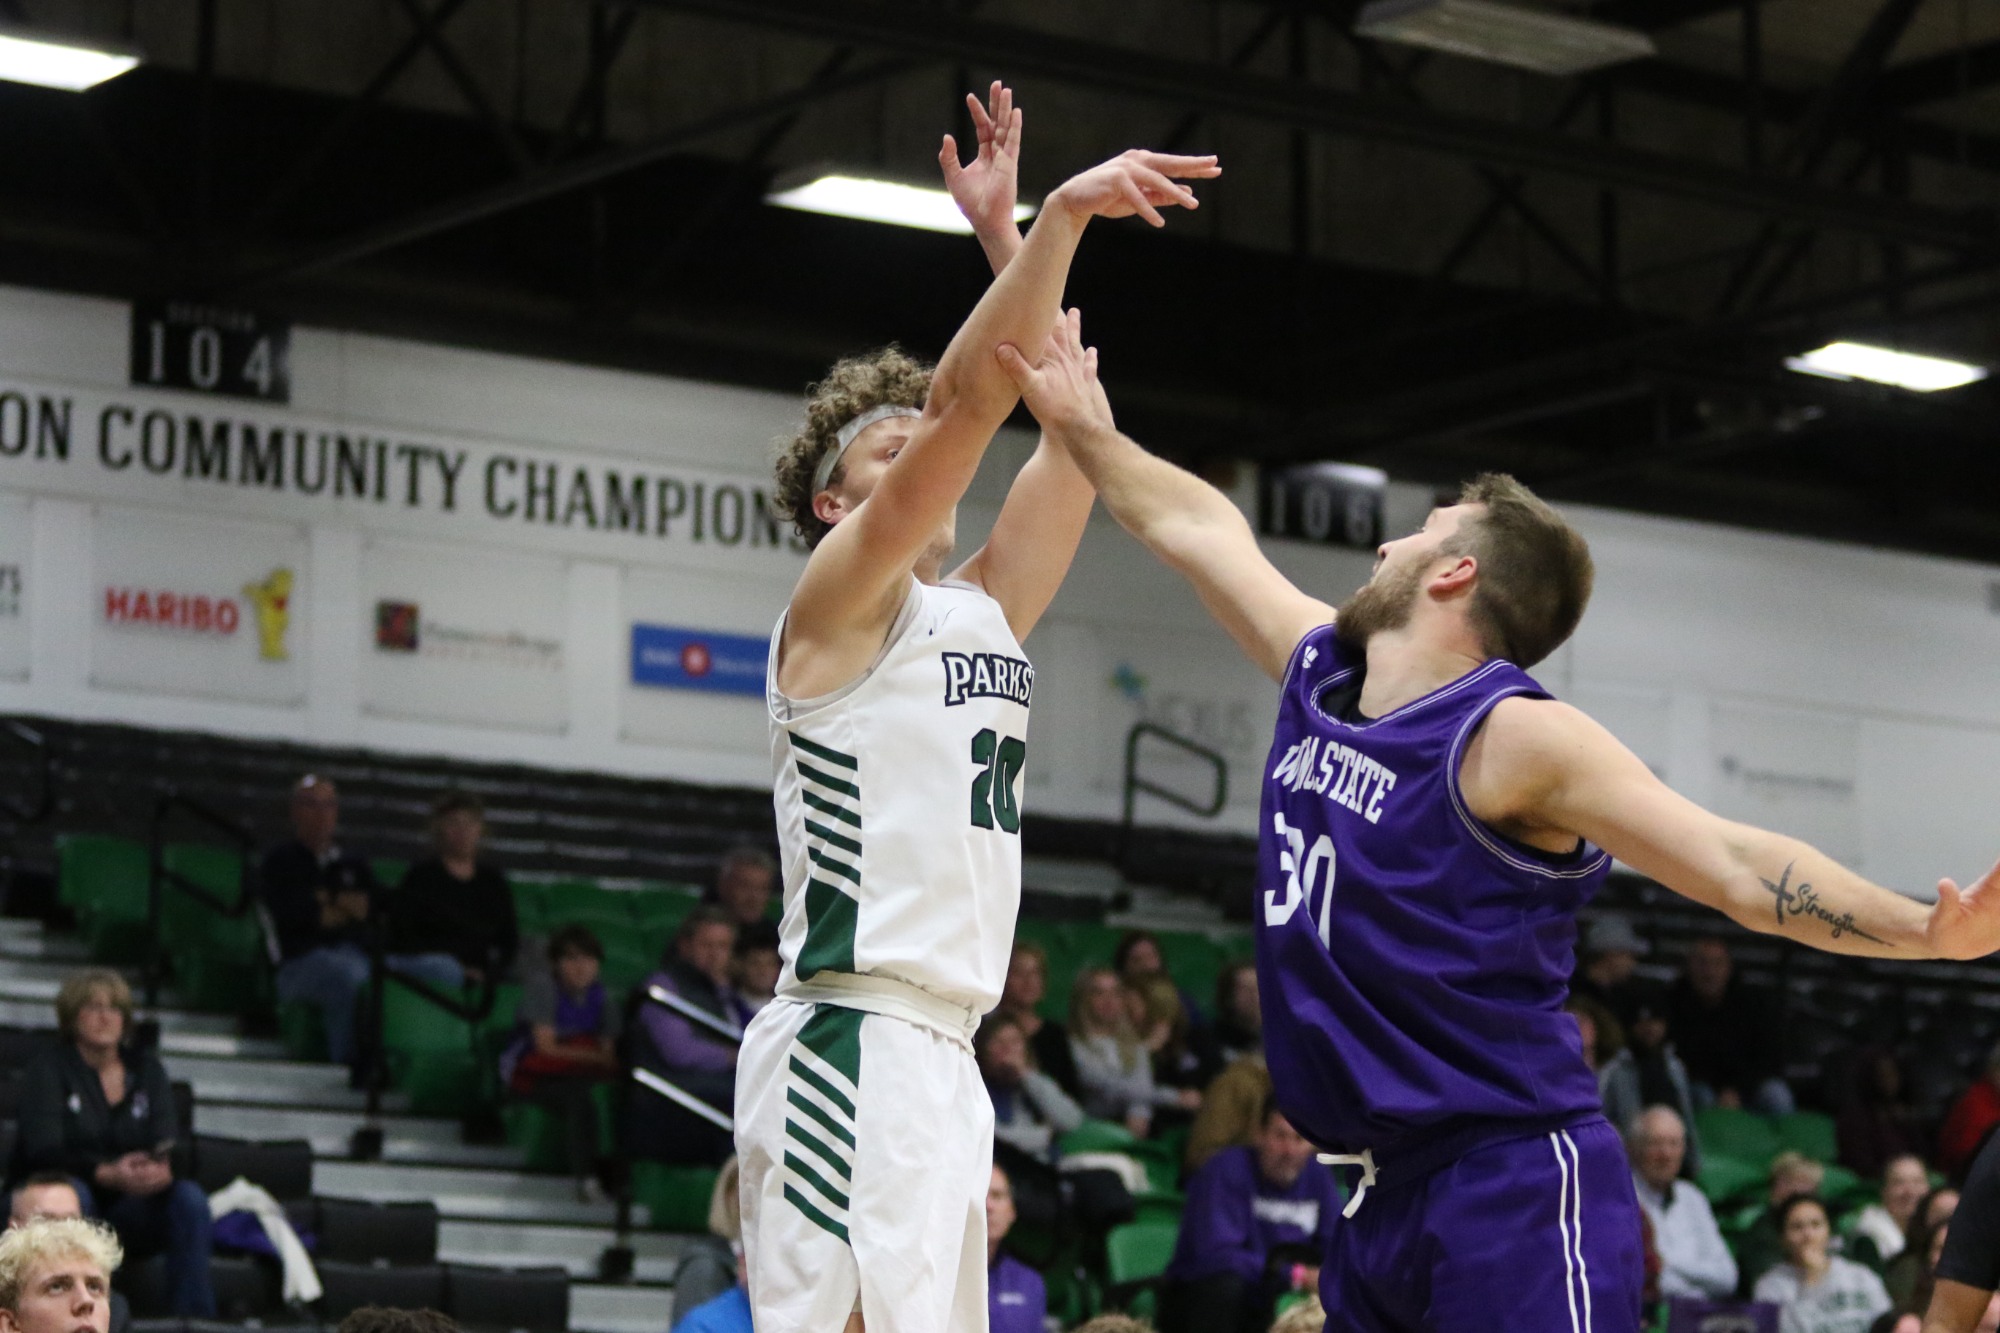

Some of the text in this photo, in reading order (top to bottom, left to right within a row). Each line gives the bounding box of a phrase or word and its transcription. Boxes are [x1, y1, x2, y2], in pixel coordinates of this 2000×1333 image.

[149, 320, 272, 396] 104
[100, 403, 467, 512] COMMUNITY
[105, 586, 240, 635] HARIBO
[971, 728, 1026, 835] 20
[1264, 811, 1337, 951] 30
[1788, 883, 1895, 947] Strength
